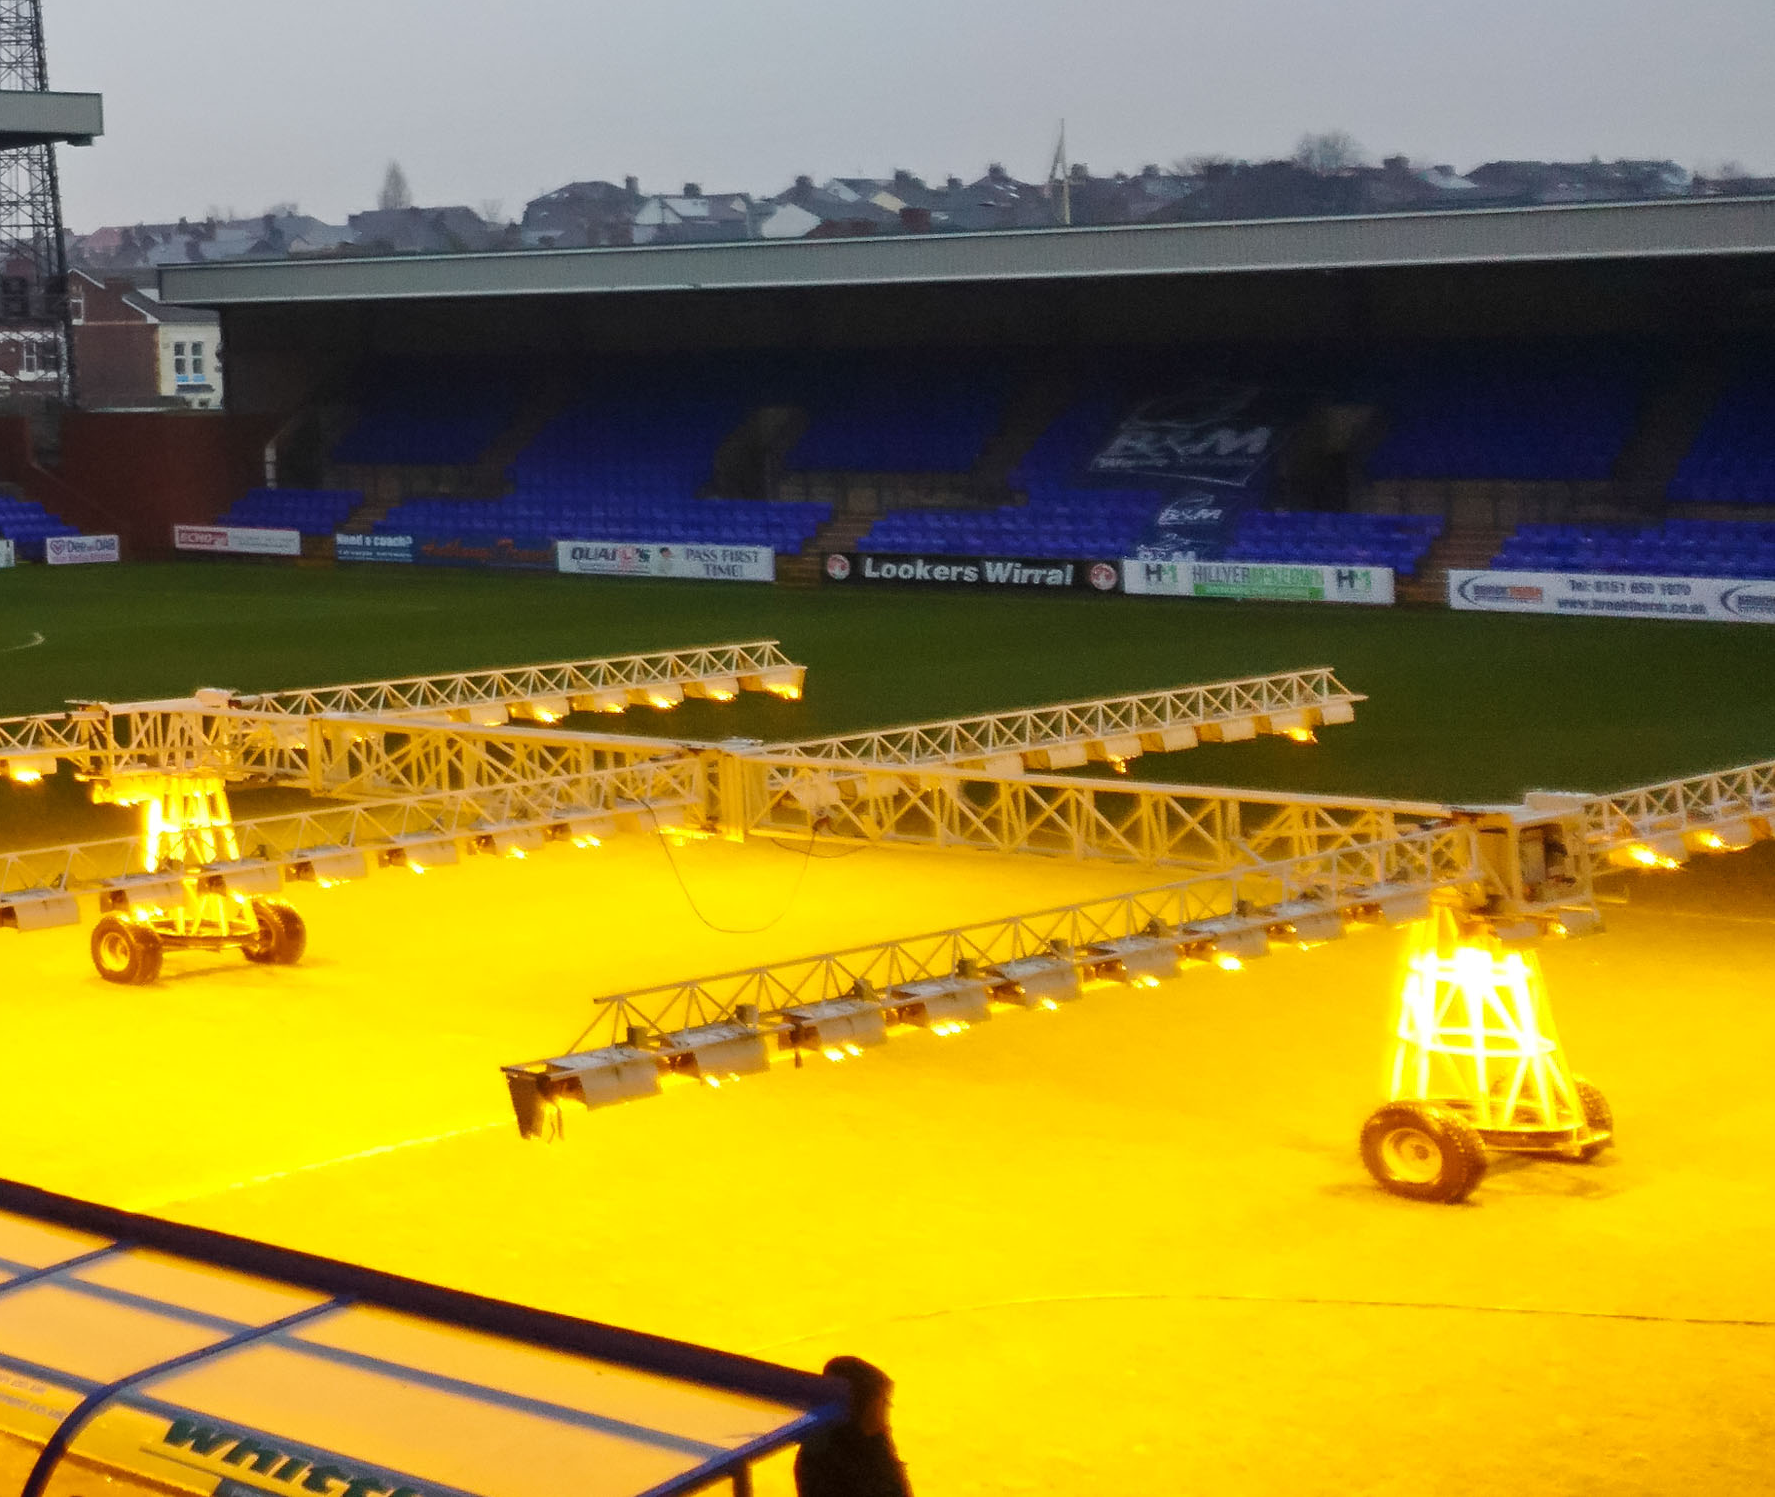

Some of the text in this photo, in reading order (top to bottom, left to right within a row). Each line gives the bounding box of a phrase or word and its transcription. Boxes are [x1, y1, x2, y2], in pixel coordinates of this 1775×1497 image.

[686, 549, 759, 563] PASS FIRST
[864, 558, 1074, 585] Lookers Wirral
[1193, 566, 1249, 583] HILLYER
